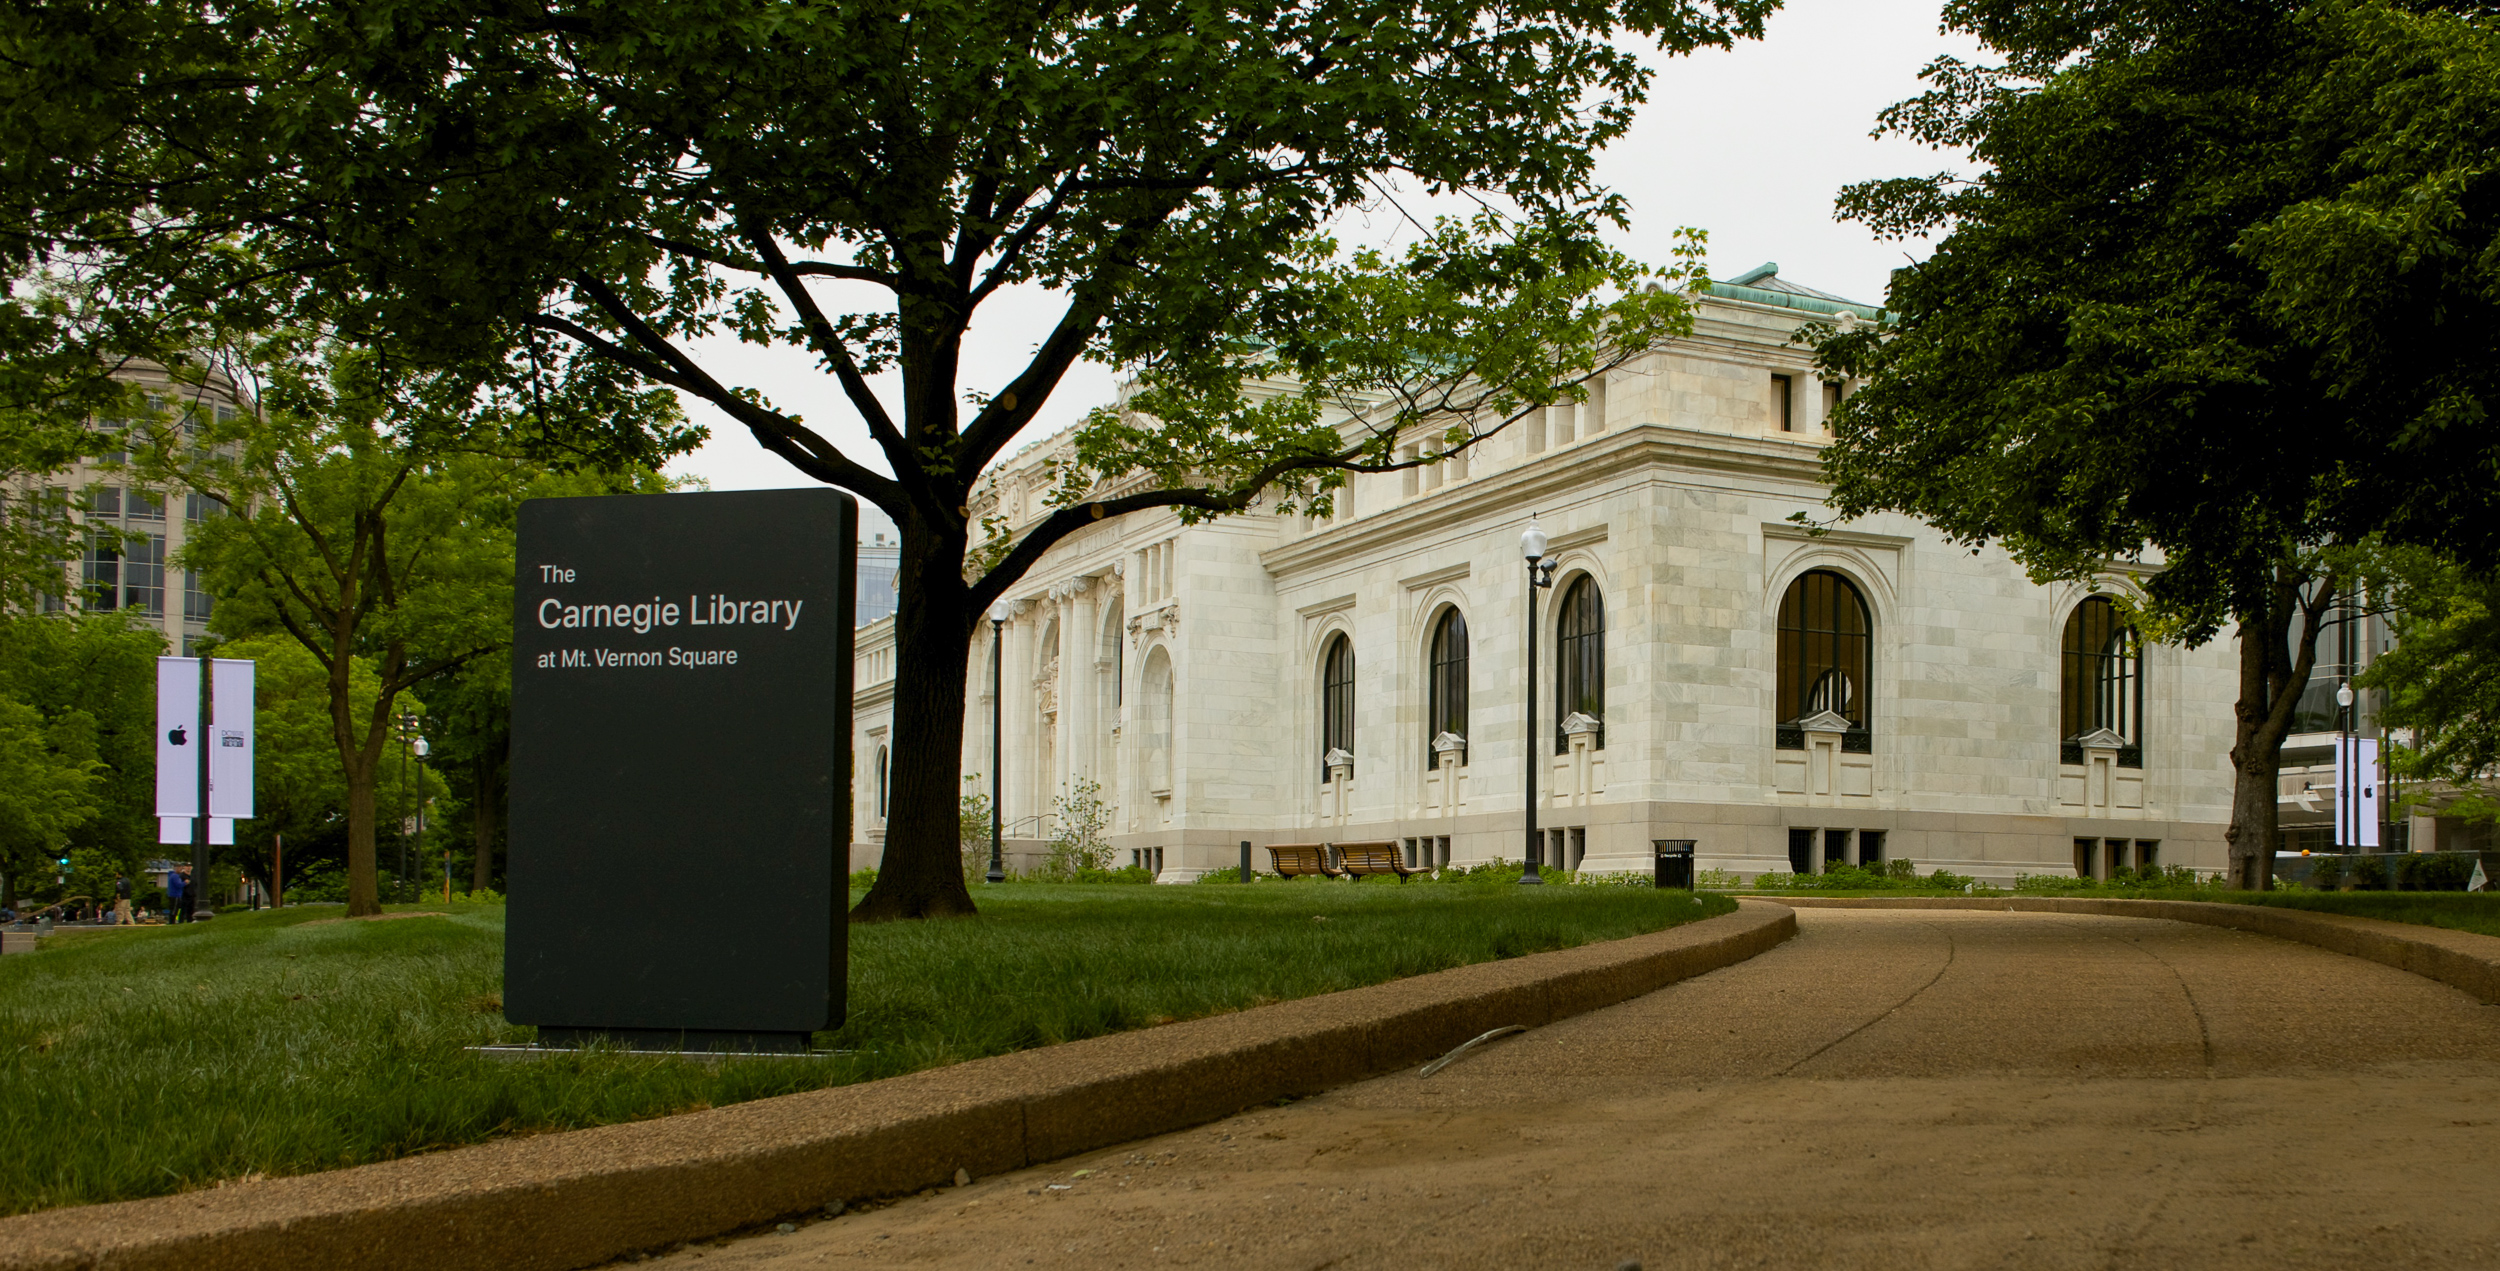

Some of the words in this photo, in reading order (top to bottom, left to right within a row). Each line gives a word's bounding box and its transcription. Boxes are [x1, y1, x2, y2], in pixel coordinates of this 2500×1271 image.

[1084, 525, 1123, 553] HISTORY
[540, 565, 576, 583] The
[538, 596, 680, 634] Carnegie
[690, 594, 804, 630] Library
[537, 651, 556, 668] at
[561, 649, 591, 668] Mt.
[594, 649, 662, 667] Vernon
[668, 647, 738, 669] Square
